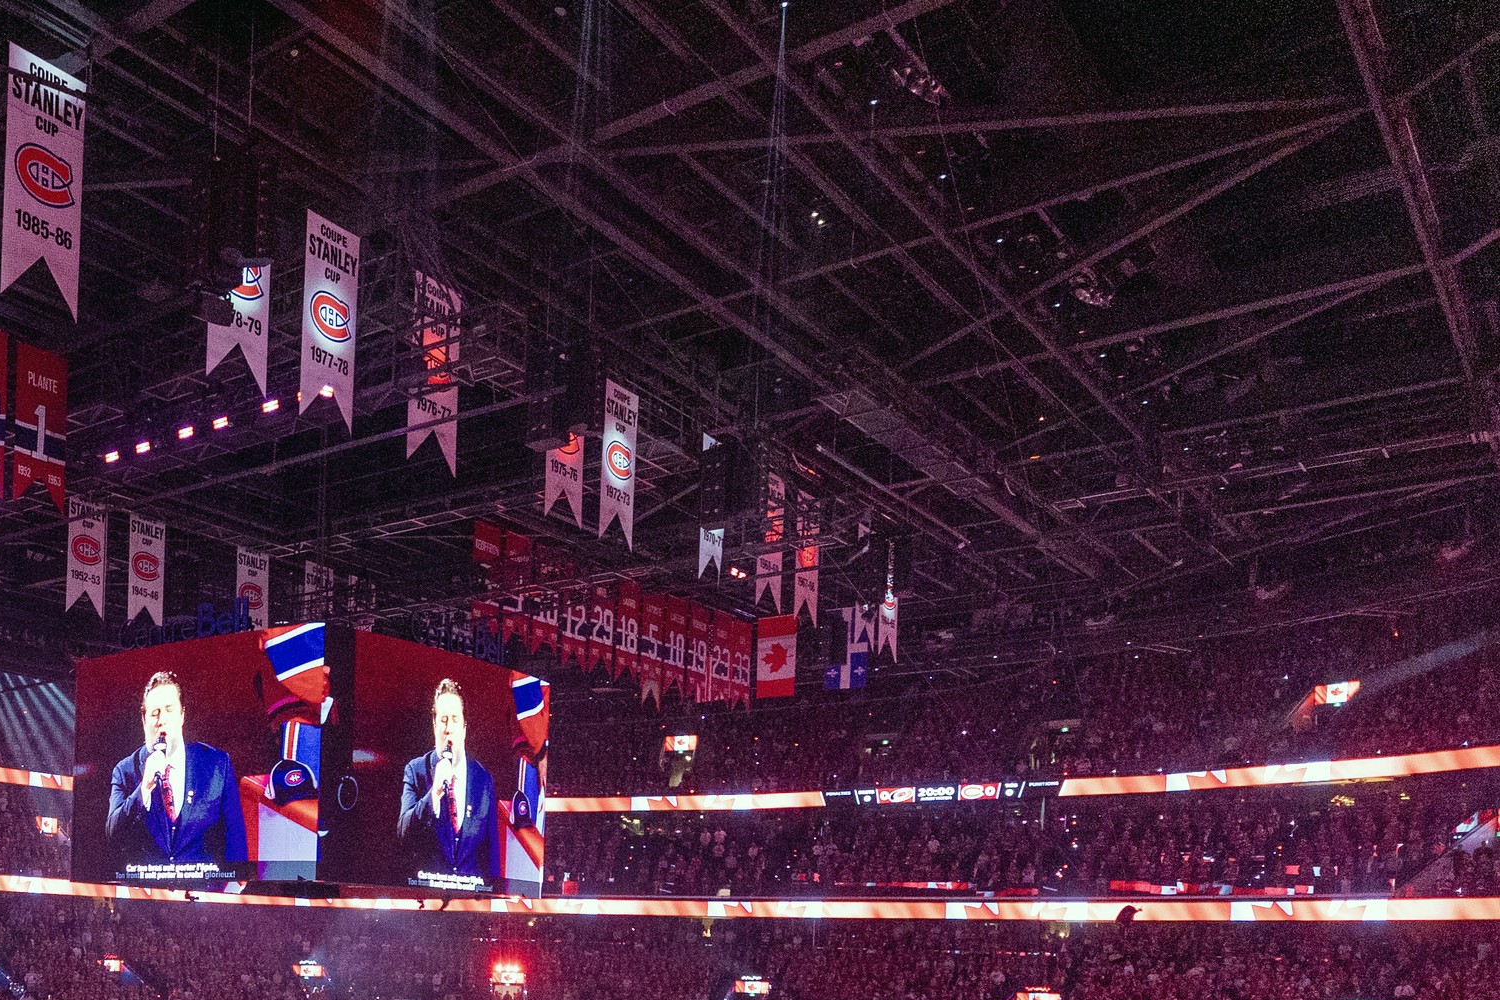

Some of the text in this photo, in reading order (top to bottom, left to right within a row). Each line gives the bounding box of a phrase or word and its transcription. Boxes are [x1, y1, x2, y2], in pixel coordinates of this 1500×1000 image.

[12, 73, 83, 130] STANLEY
[36, 116, 59, 137] CUP
[15, 209, 72, 250] 1985-86
[320, 224, 347, 248] COUPE
[308, 234, 358, 277] STANLEY
[324, 267, 340, 284] CUP
[230, 309, 262, 336] 78-79
[310, 345, 349, 376] 1977-78
[28, 371, 58, 394] PLANTE
[606, 398, 638, 427] STANLEY
[31, 404, 48, 462] 1
[17, 464, 32, 478] 1952
[47, 474, 62, 487] 1963
[551, 459, 578, 481] 1975-76
[606, 485, 630, 506] 1972-73
[131, 520, 164, 541] STANLEY
[703, 529, 723, 548] 1970-7
[238, 555, 267, 571] STANLEY
[71, 569, 101, 585] 1952-53
[131, 585, 159, 600] 1945-46
[198, 597, 249, 638] Bell
[592, 606, 613, 646] 29
[917, 787, 955, 797] 20:00
[204, 870, 236, 880] glorieux!
